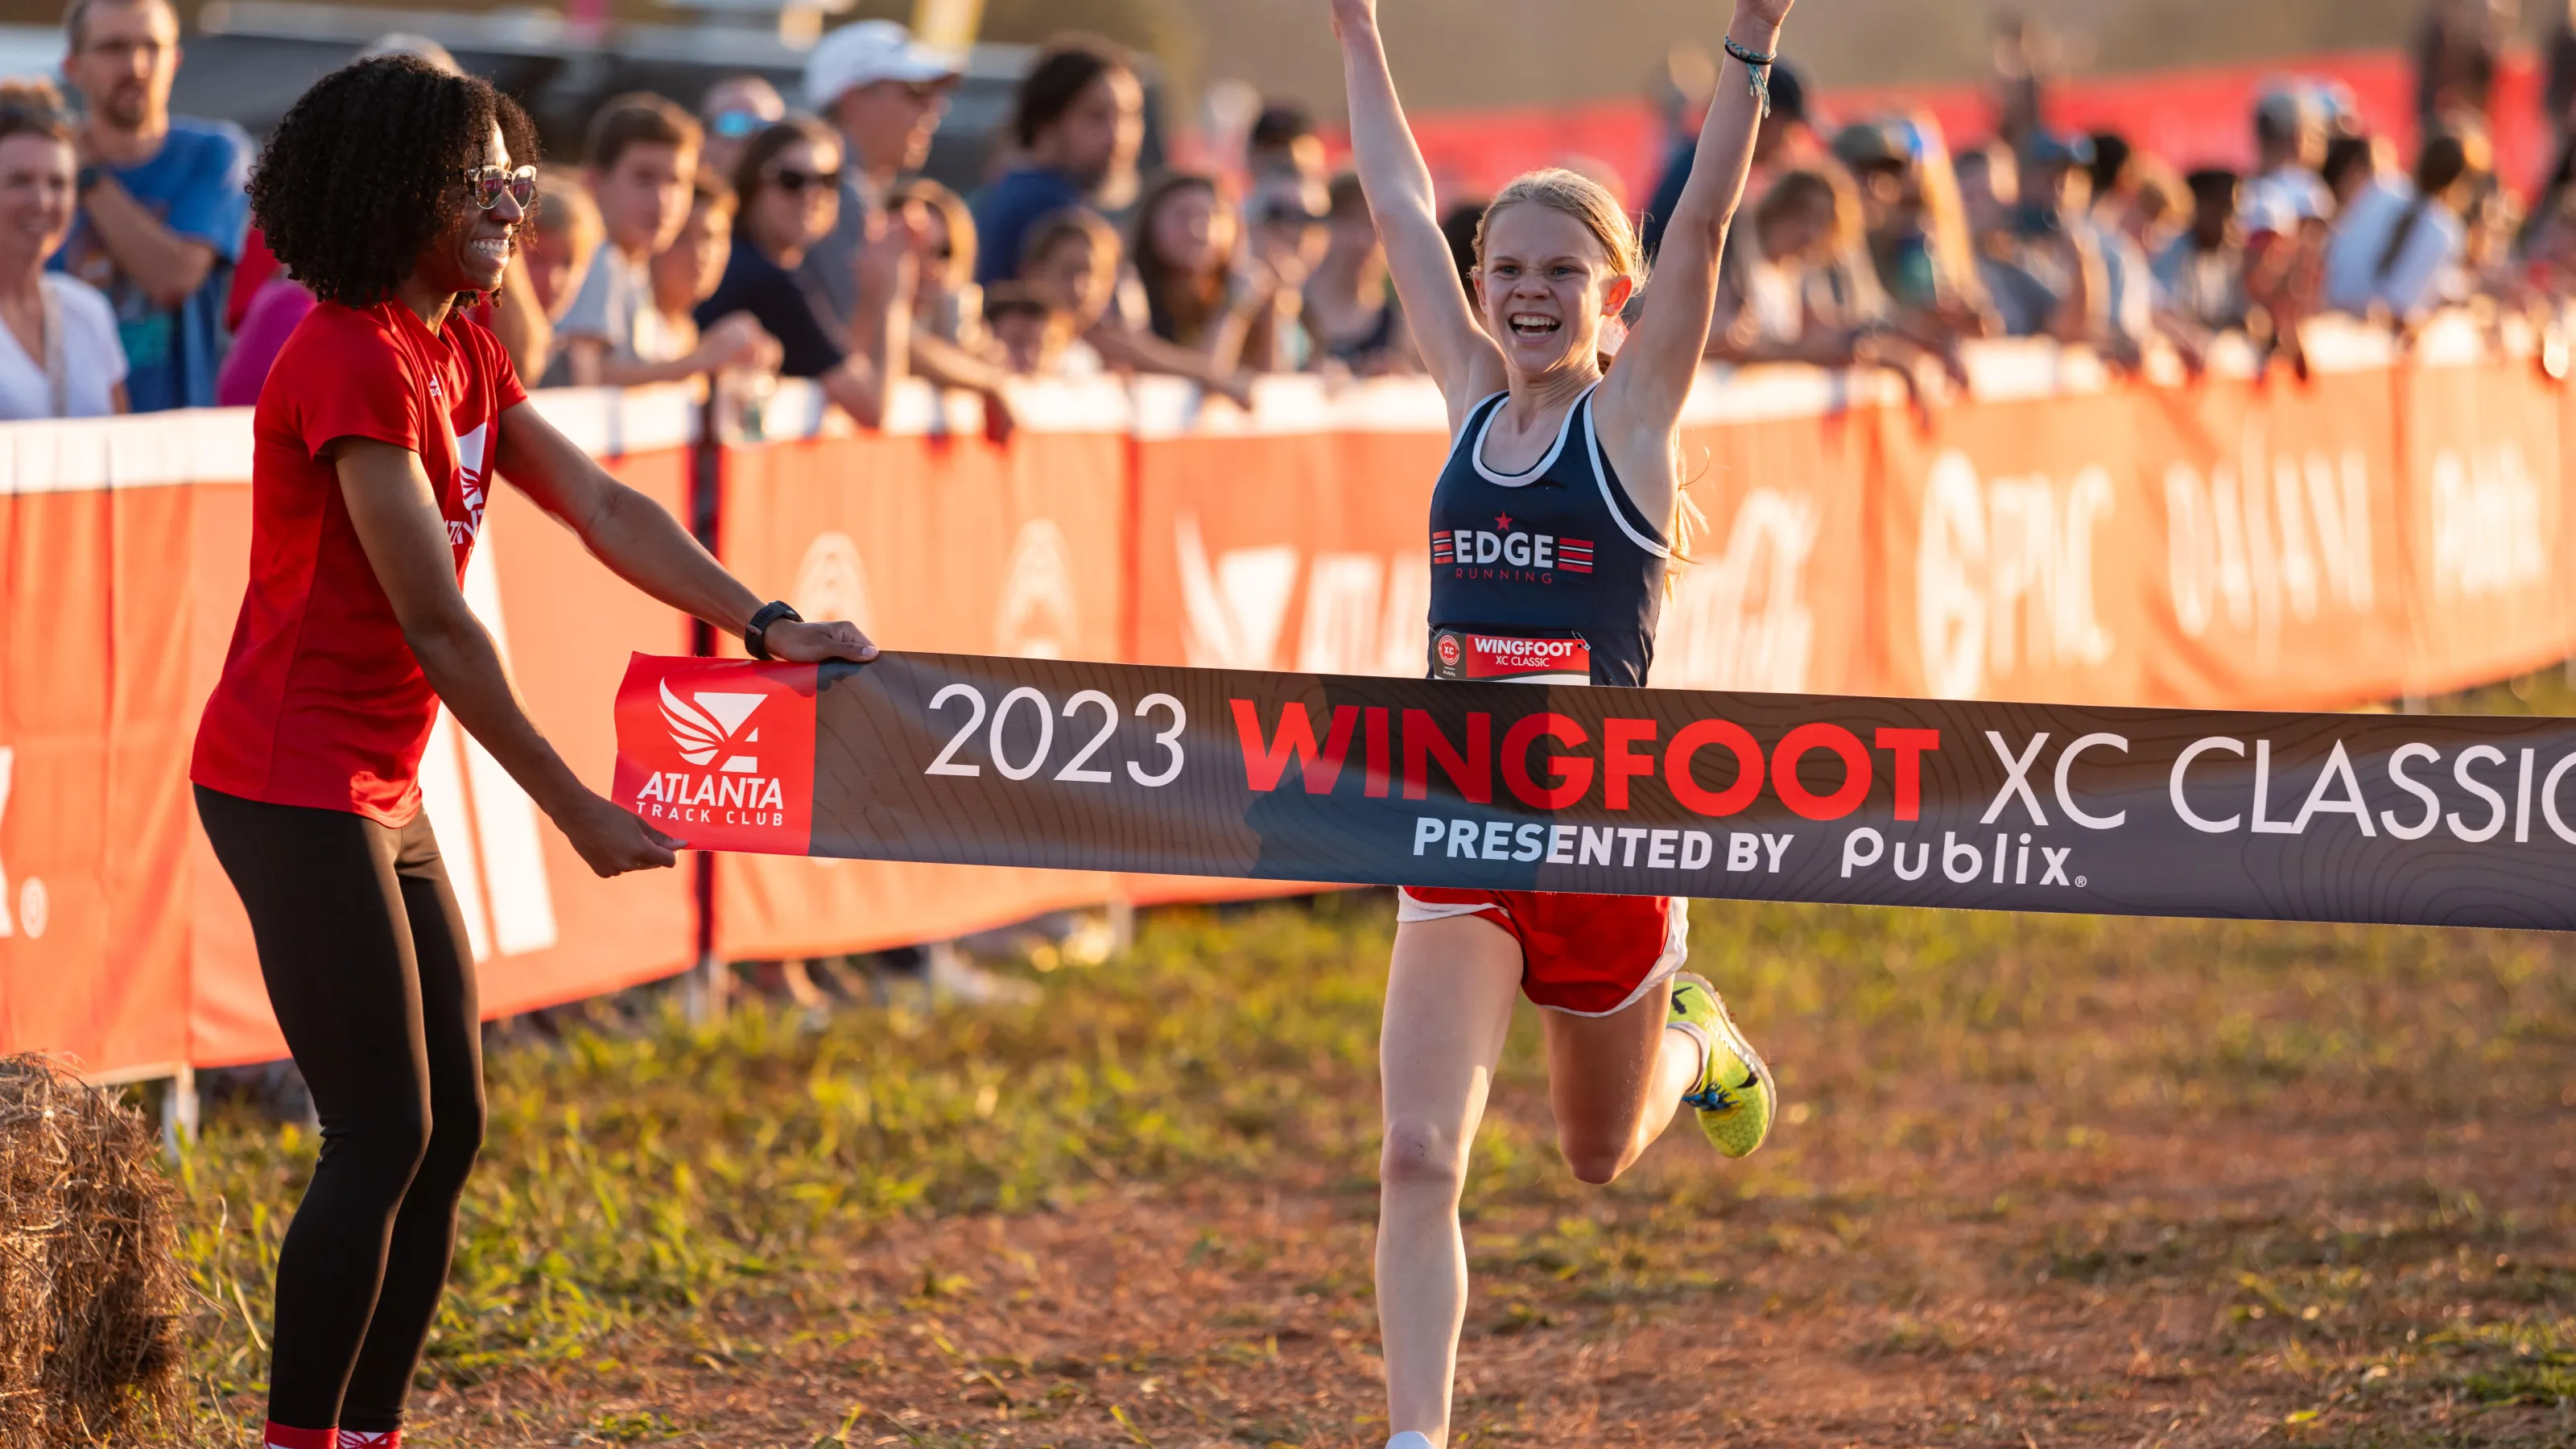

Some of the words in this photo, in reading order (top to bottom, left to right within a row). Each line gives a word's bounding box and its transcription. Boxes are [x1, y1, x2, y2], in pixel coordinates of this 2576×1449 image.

[1454, 530, 1554, 568] EDGE
[1455, 568, 1553, 584] RUNNING
[1443, 645, 1454, 655] XC
[1474, 638, 1574, 657] WINGFOOT
[1496, 655, 1509, 665] XC
[1510, 656, 1550, 667] CLASSIC
[924, 683, 1187, 787] 2023
[1228, 698, 1940, 822] WINGFOOT
[1979, 731, 2128, 830] XC
[637, 771, 783, 810] ATLANTA
[636, 802, 711, 823] TRACK
[726, 811, 783, 827] CLUB
[1413, 817, 1713, 870] PRESENTED
[1726, 832, 1794, 873] BY
